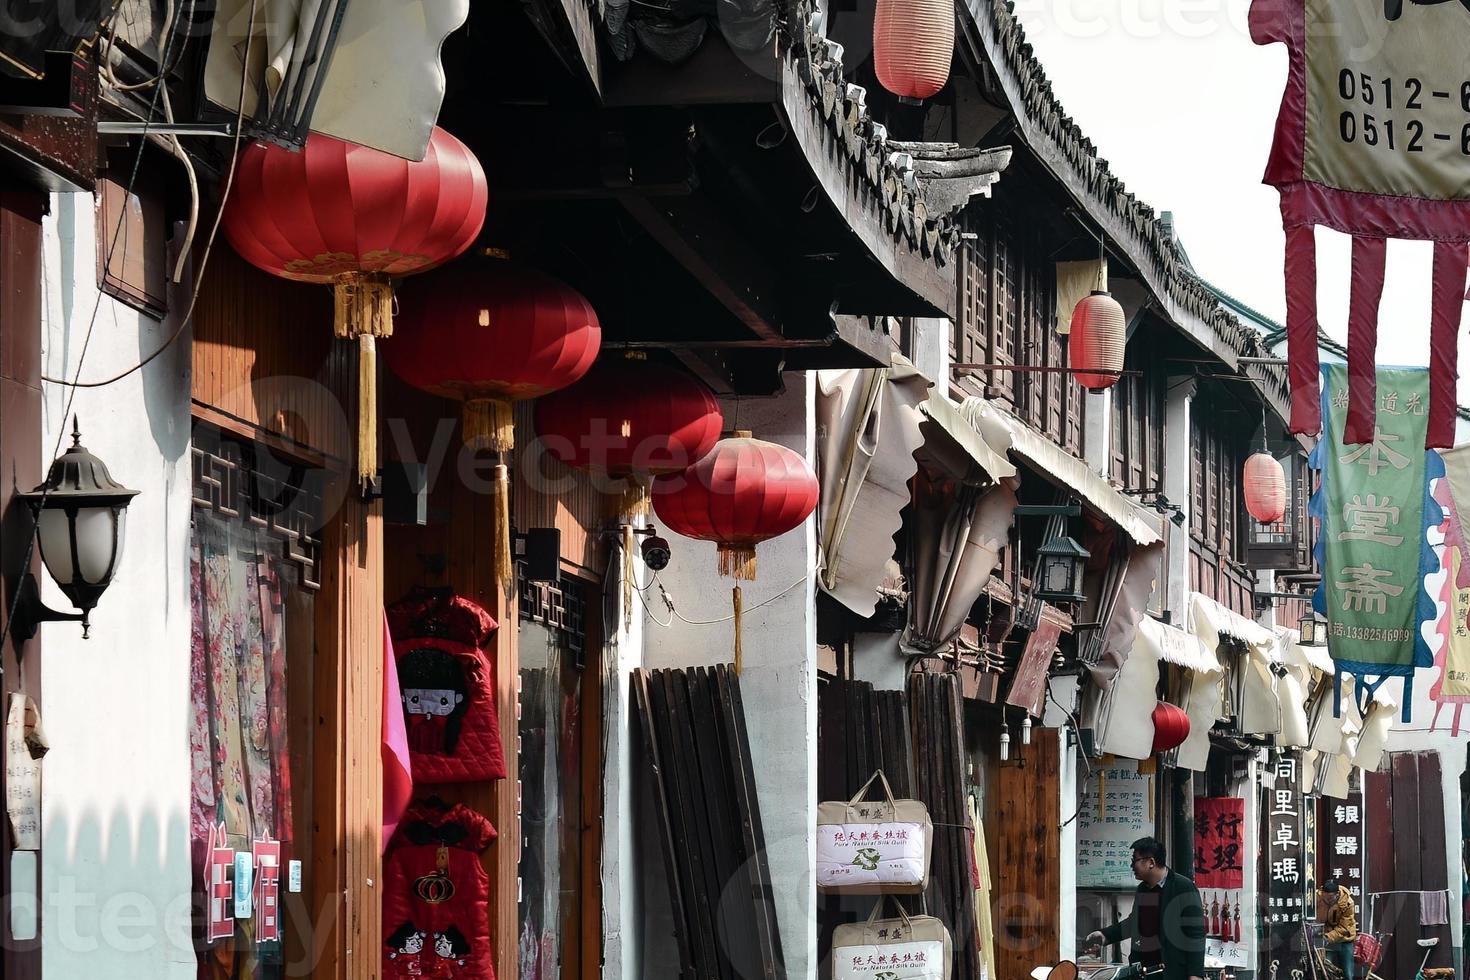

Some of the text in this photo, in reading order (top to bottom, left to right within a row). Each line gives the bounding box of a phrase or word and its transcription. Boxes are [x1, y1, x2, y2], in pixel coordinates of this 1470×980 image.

[1332, 388, 1424, 416] 始道光
[1335, 425, 1410, 615] 本堂斋
[1328, 622, 1409, 642] 话:13382546989
[1271, 758, 1299, 884] 同里卓瑪
[1335, 805, 1360, 855] 银器
[834, 830, 909, 842] 纯天然蚕丝被
[852, 951, 926, 966] 纯天然蚕丝被
